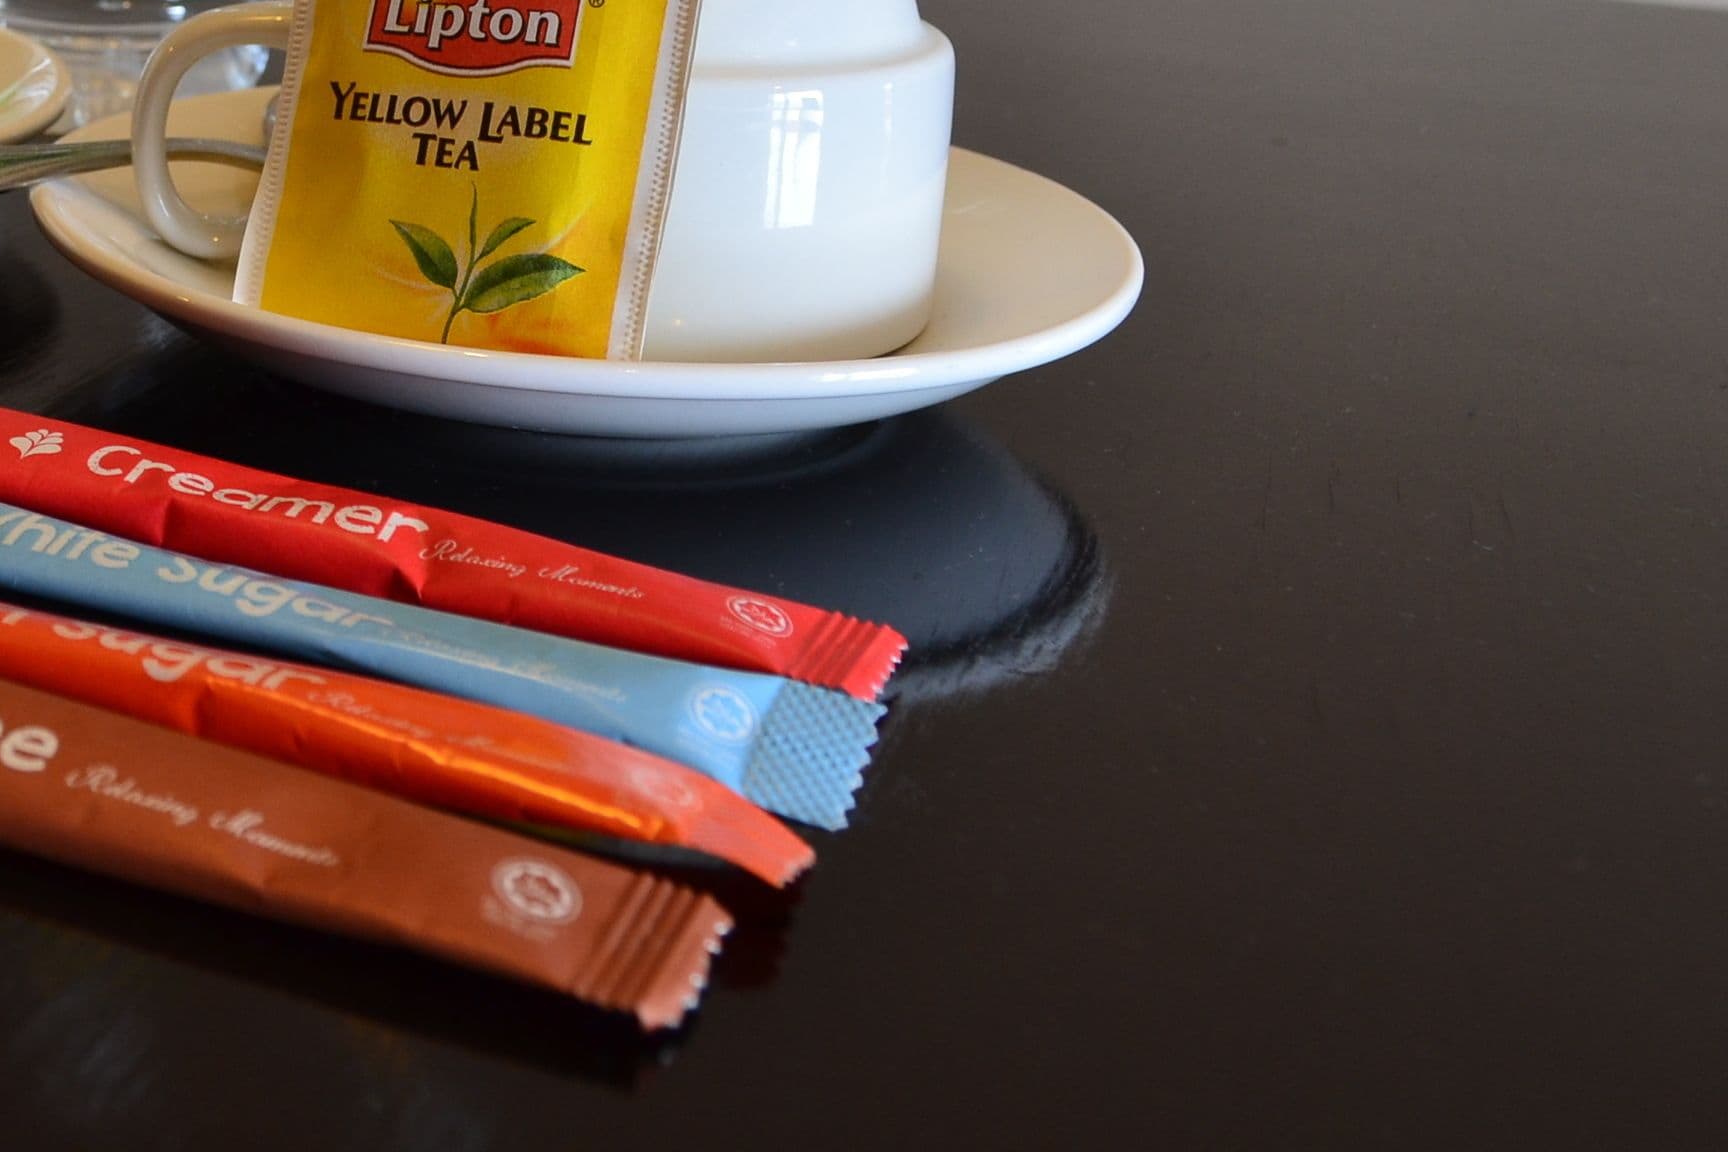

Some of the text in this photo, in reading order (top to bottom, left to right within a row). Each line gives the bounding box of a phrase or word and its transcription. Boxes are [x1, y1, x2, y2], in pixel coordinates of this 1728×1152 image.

[329, 81, 593, 147] YELLOW LABEL
[412, 132, 480, 172] TEA
[85, 444, 430, 544] Creamer
[418, 538, 527, 579] Relaxing
[156, 554, 396, 630] Sugar
[65, 764, 200, 829] Relaxing
